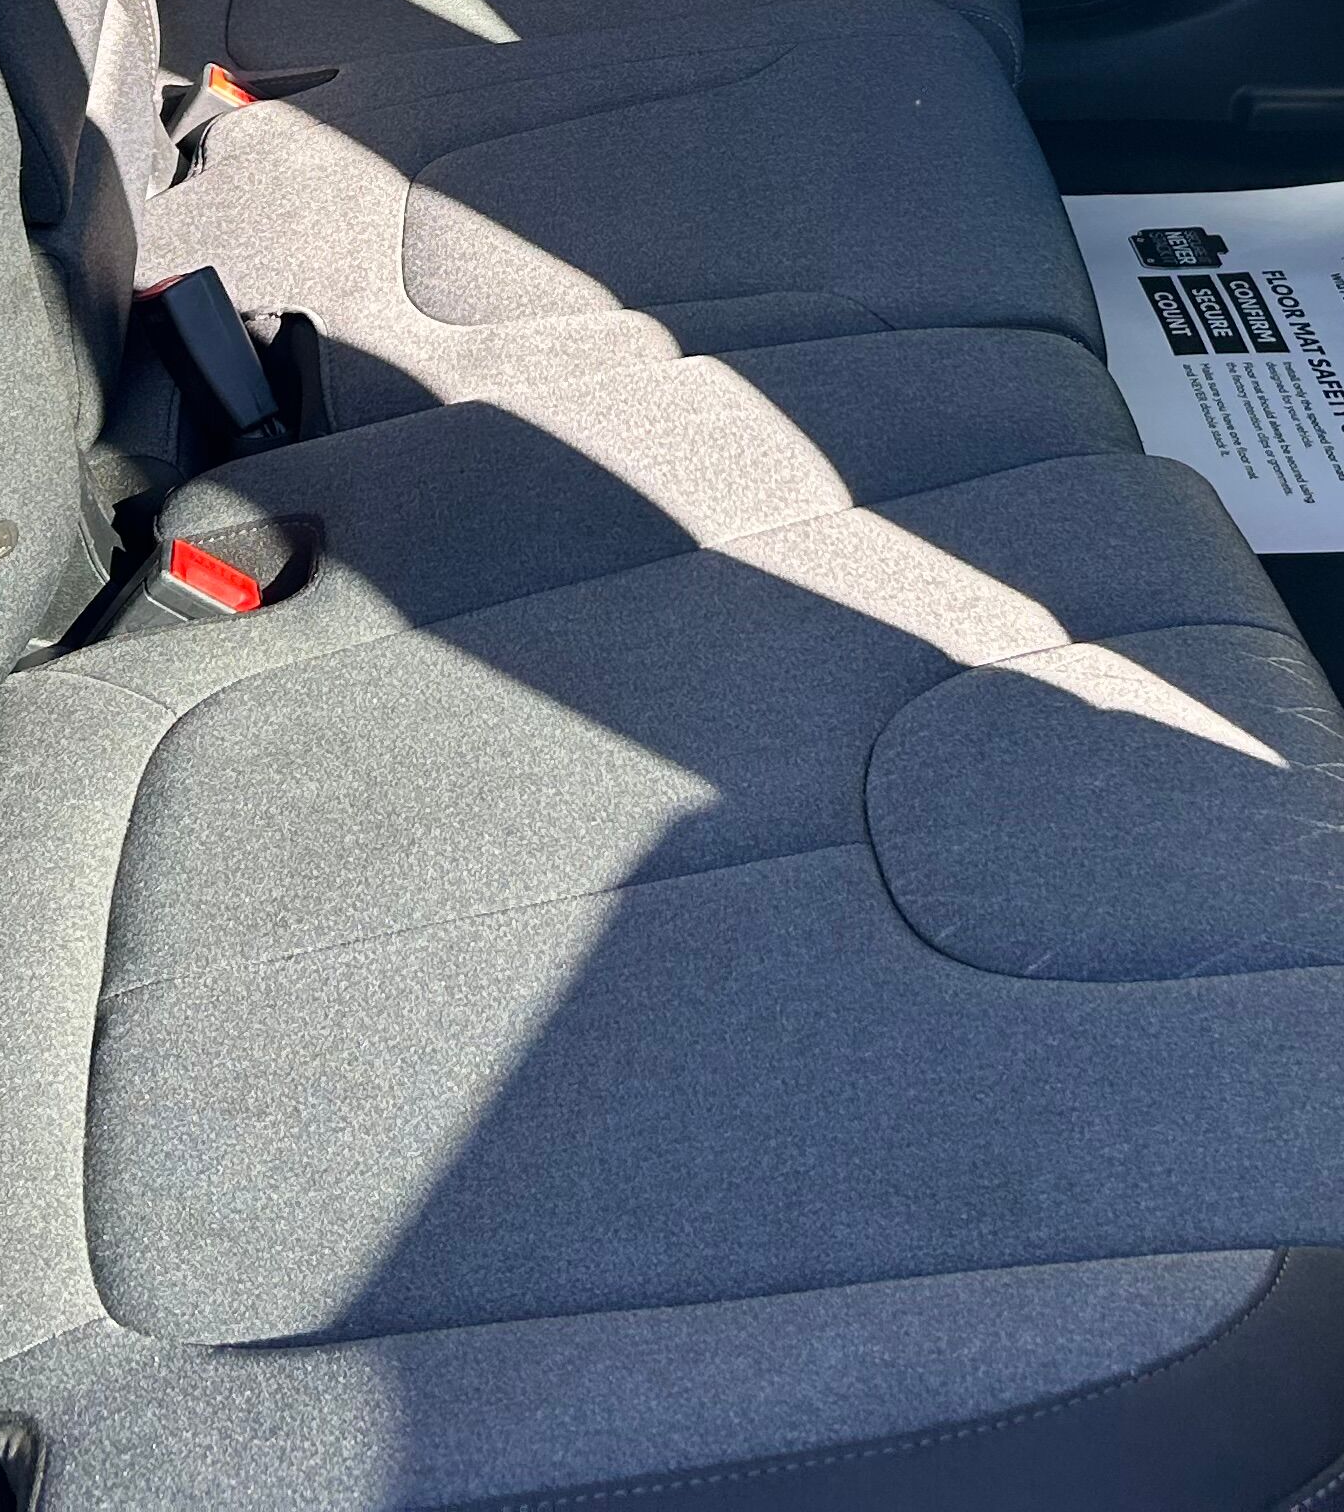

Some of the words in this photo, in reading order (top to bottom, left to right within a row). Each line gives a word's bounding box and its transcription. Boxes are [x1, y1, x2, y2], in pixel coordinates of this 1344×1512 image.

[1165, 231, 1197, 265] NEVER
[1154, 292, 1191, 336] COUNT
[1192, 289, 1233, 336] SECURE
[1230, 281, 1276, 342] CONFIRM
[1262, 271, 1305, 318] FLOOR
[1289, 323, 1325, 355] MAT
